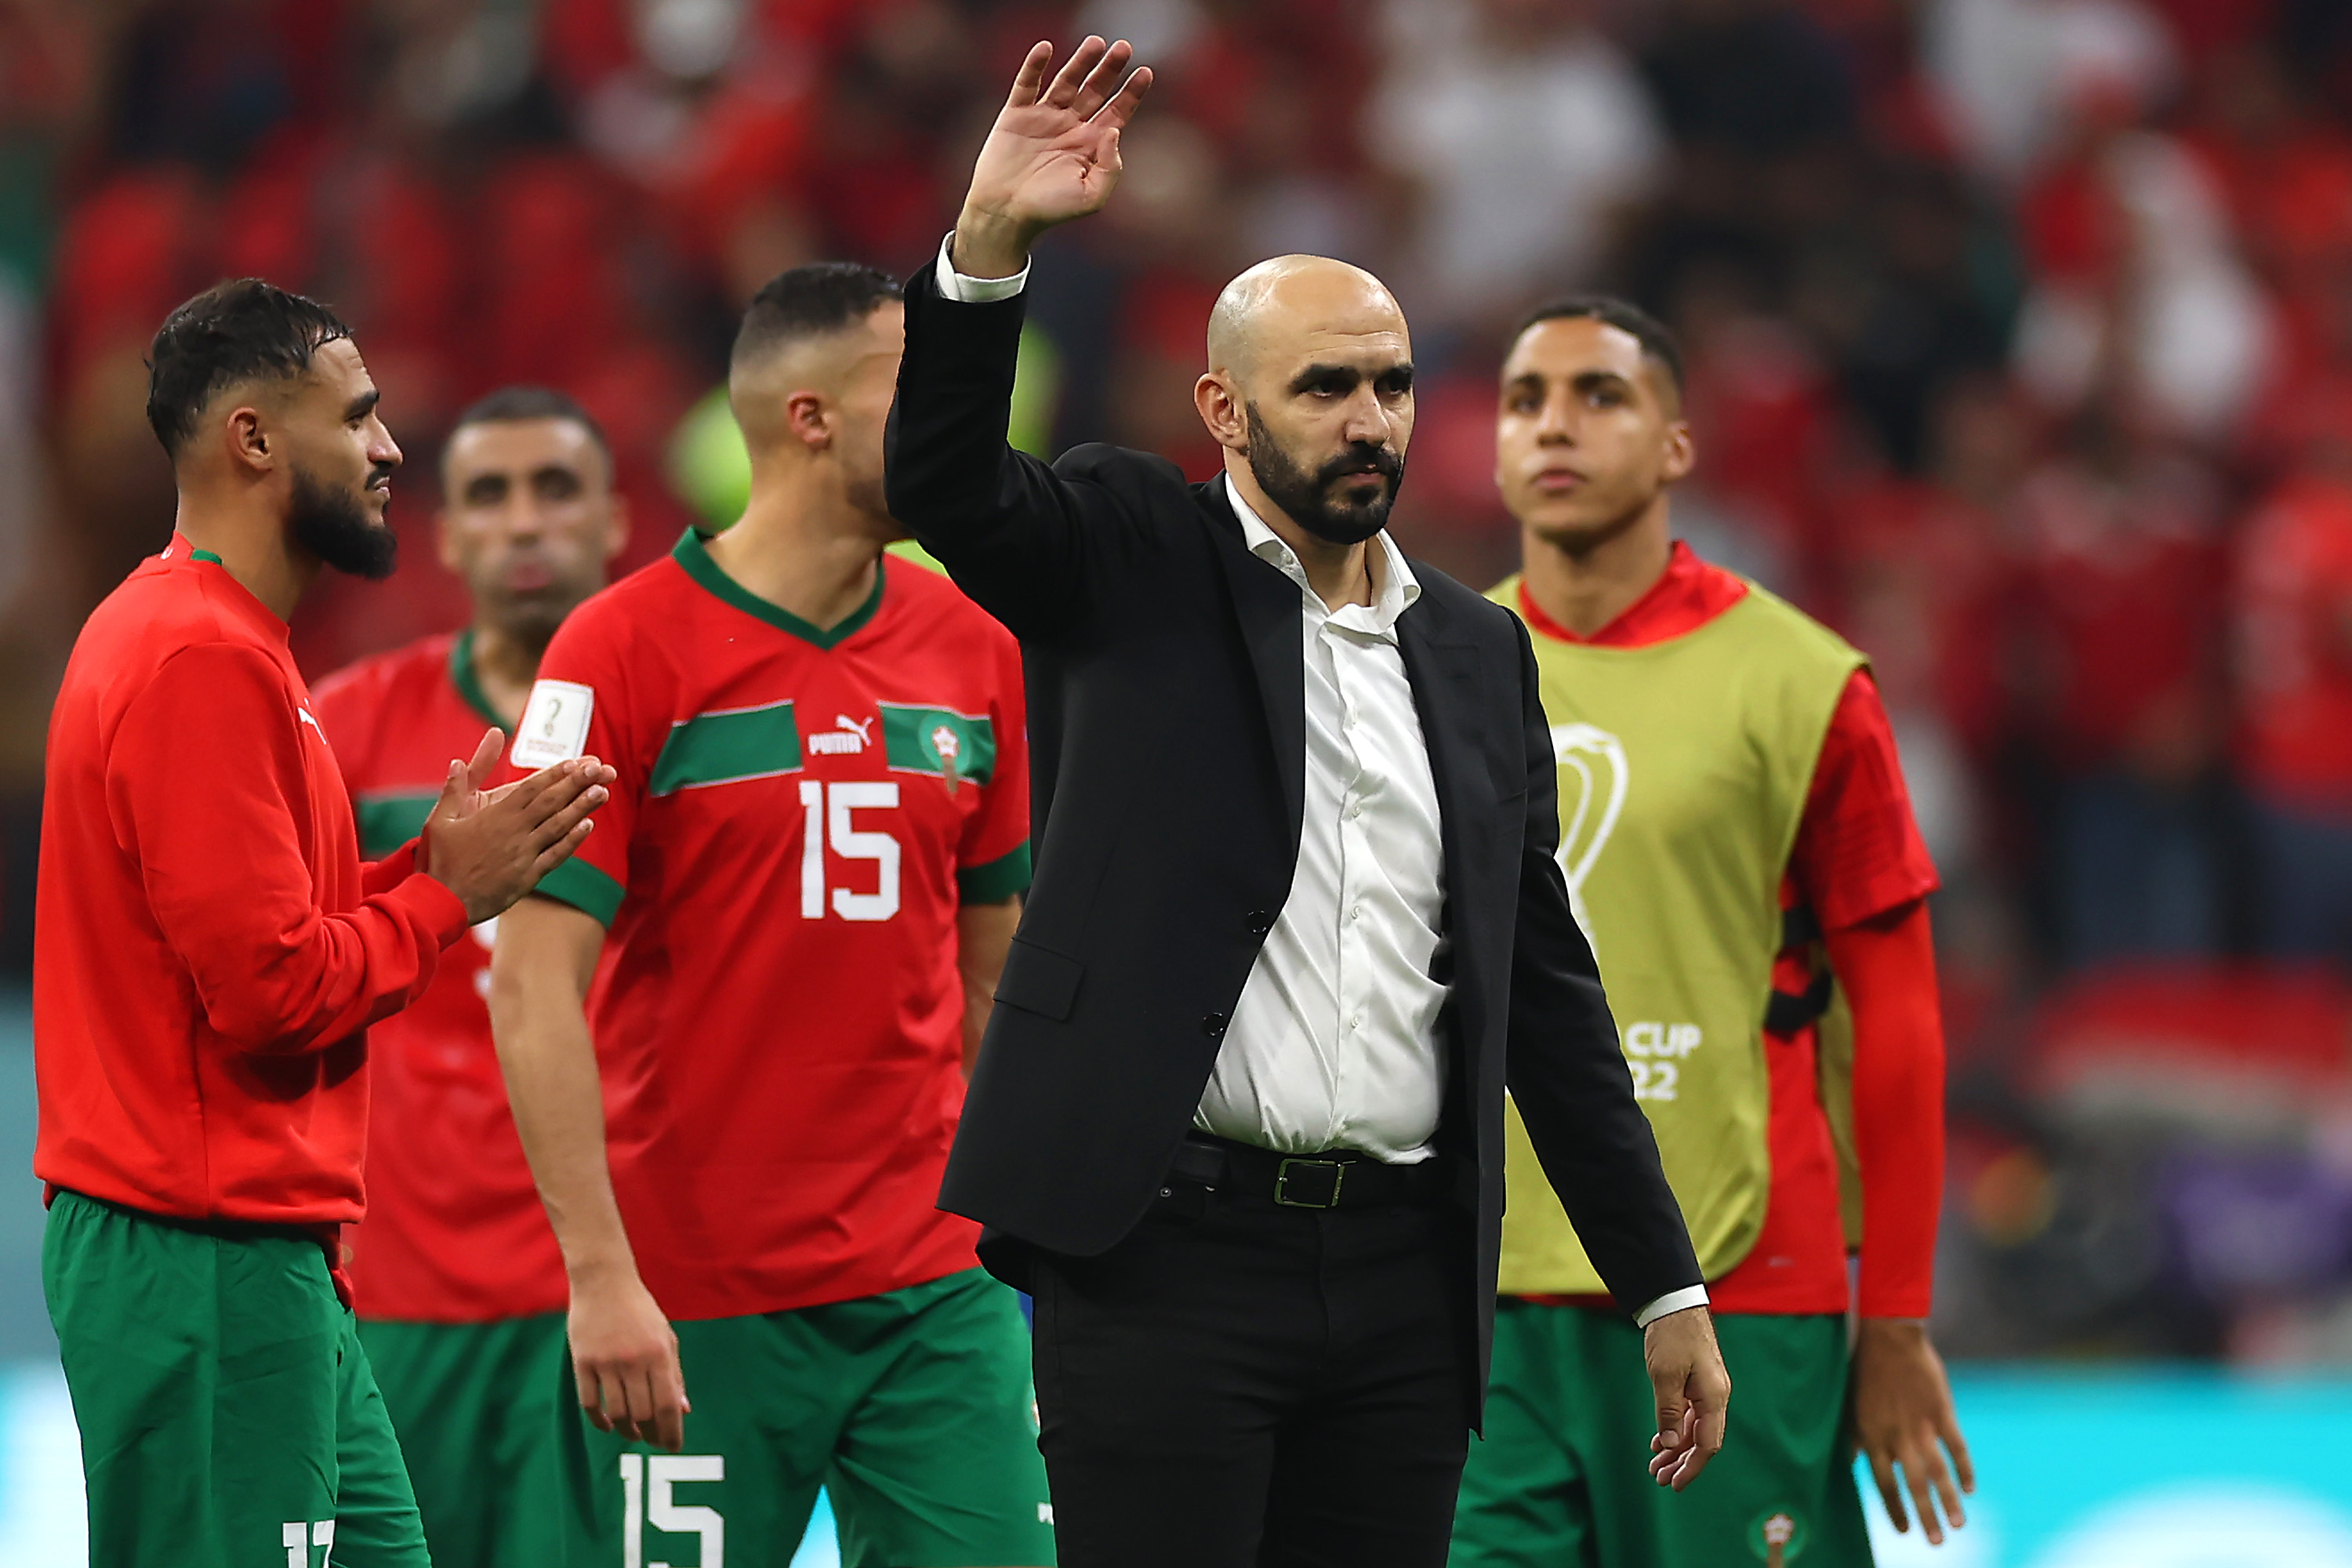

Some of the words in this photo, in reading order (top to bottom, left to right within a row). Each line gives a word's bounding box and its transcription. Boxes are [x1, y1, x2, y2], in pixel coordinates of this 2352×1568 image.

[799, 780, 900, 920] 15
[1626, 1022, 1702, 1058] CUP
[619, 1453, 724, 1568] 15
